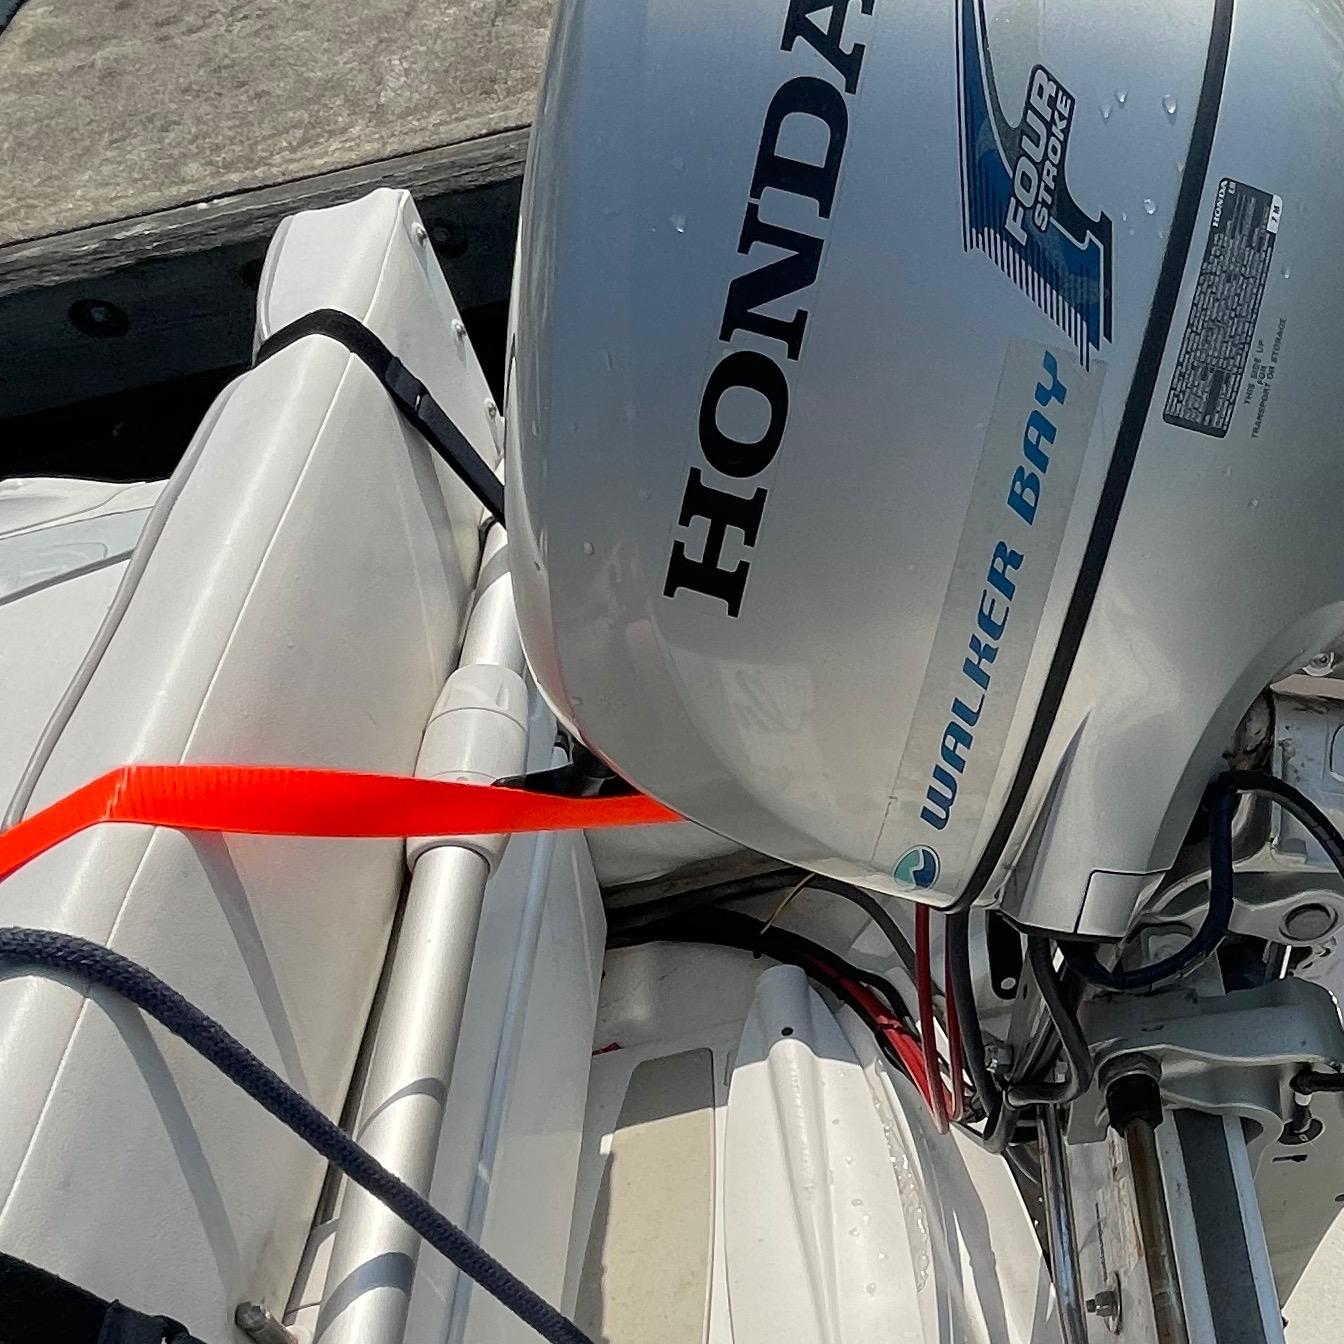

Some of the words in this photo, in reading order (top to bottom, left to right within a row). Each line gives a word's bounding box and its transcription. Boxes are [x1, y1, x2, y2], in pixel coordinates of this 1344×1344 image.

[1005, 68, 1057, 246] FOUR
[1034, 90, 1072, 230] STROKE
[1211, 180, 1228, 228] HONDA
[919, 539, 1025, 831] WALKER
[1006, 349, 1068, 526] BAY
